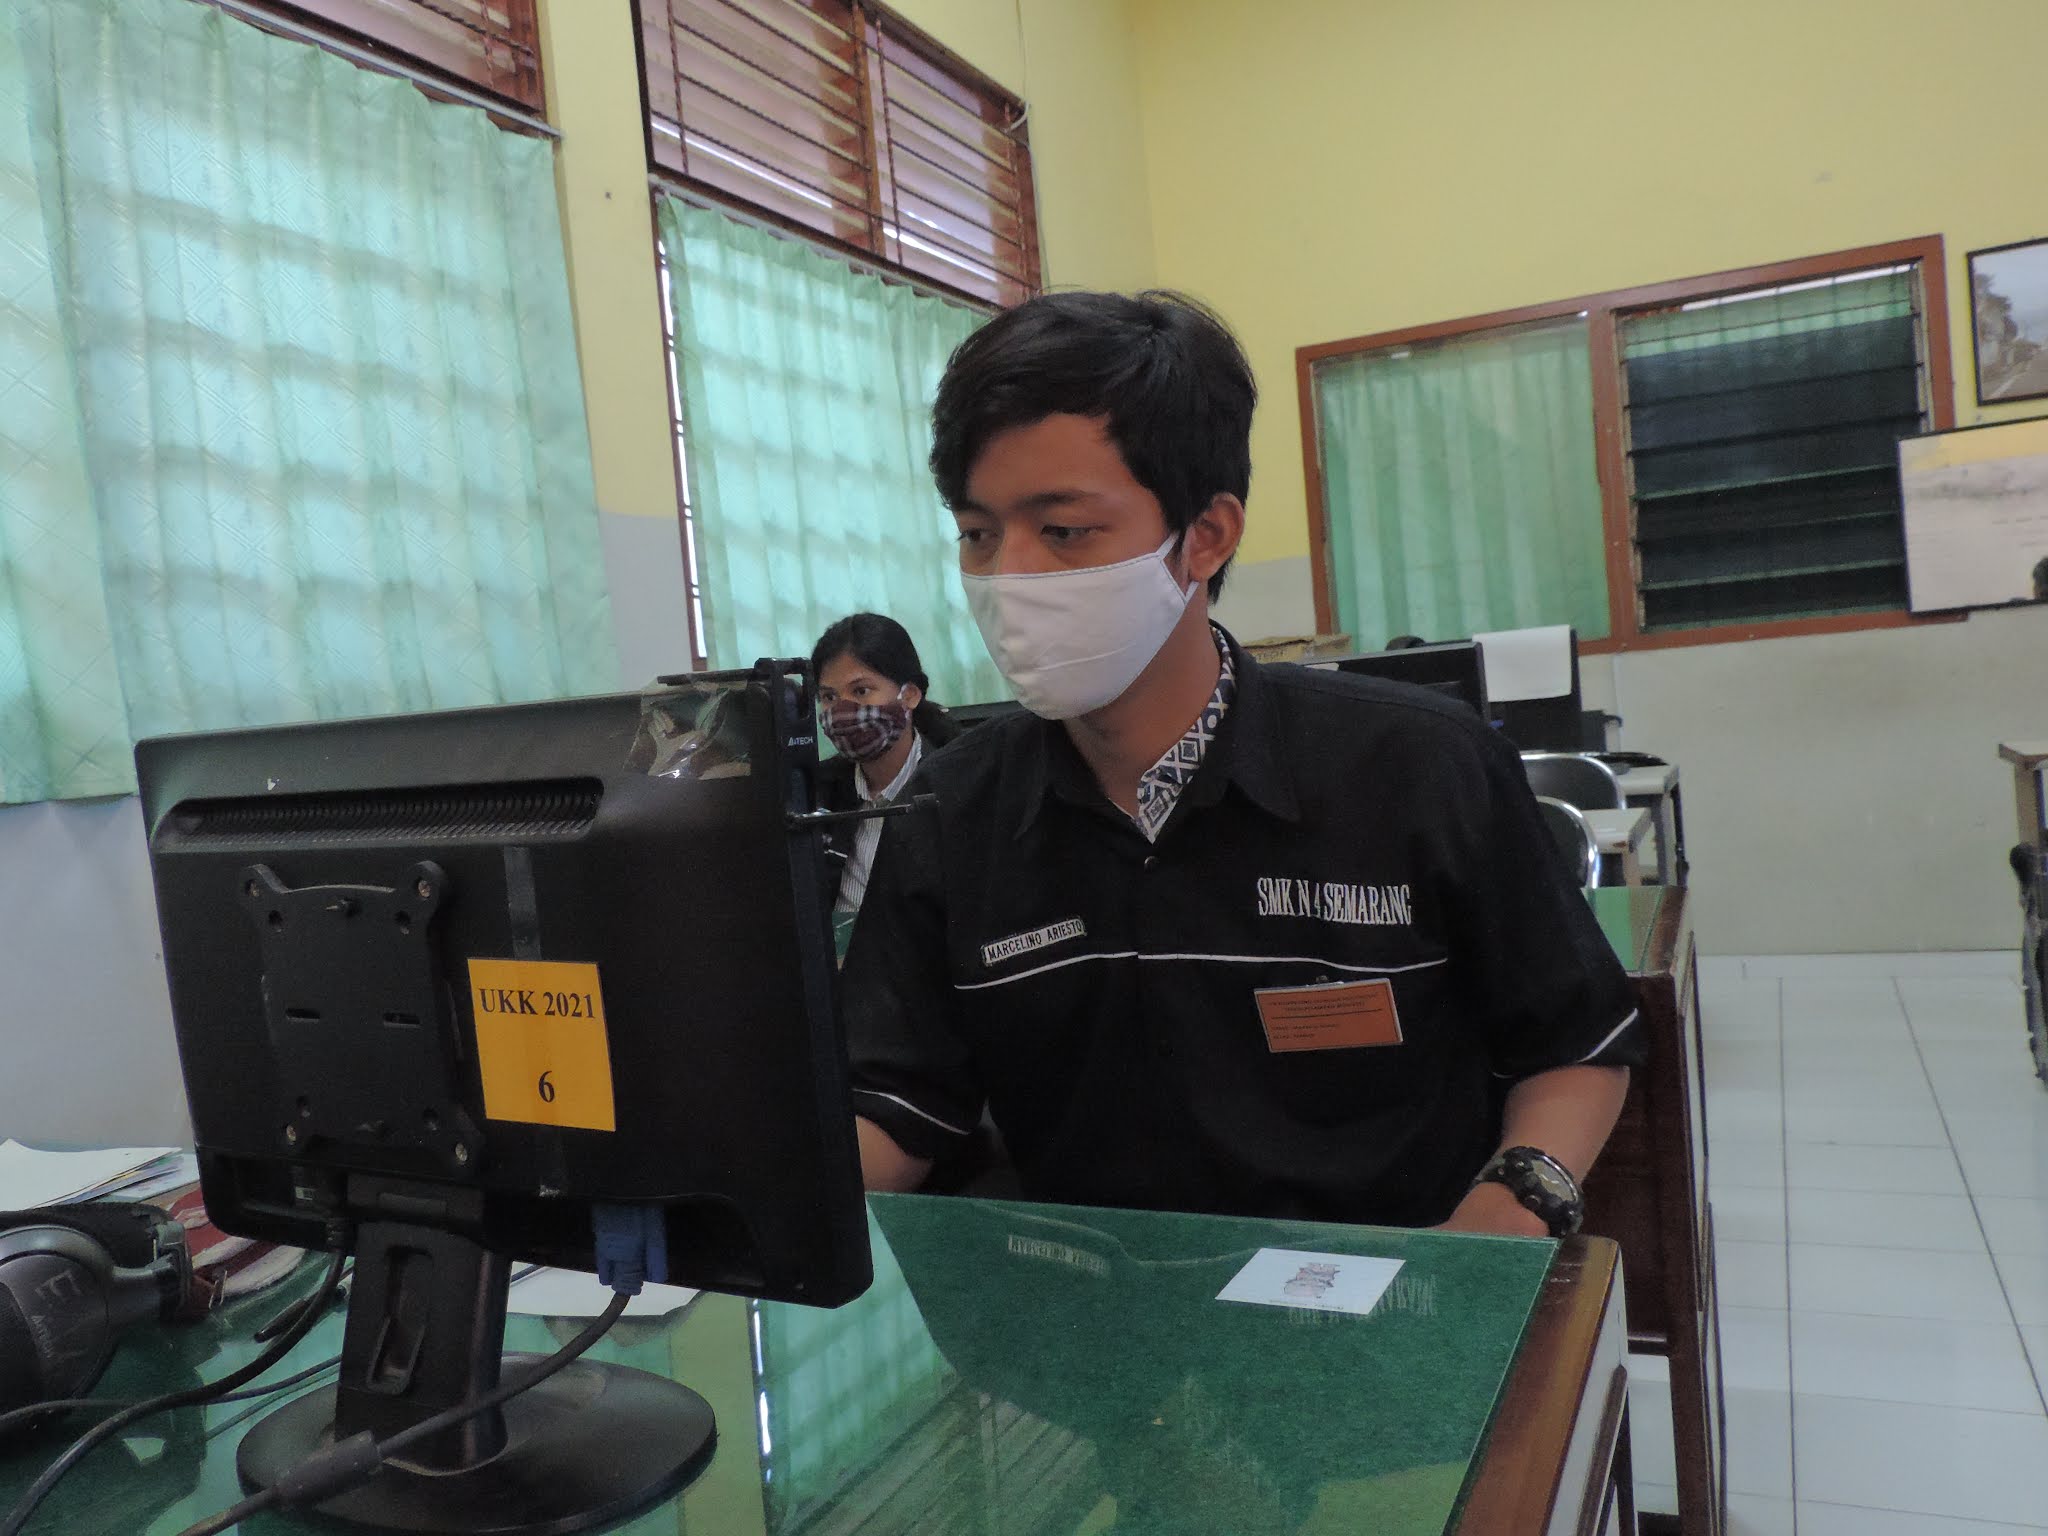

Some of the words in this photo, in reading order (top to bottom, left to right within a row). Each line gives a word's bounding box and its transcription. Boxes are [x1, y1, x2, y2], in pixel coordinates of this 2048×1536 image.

[1256, 877, 1296, 917] SMK
[1296, 879, 1312, 918] N
[1322, 882, 1412, 926] SEMARANG
[987, 932, 1042, 961] MARCELINO
[1046, 919, 1083, 942] ARIESTO
[479, 988, 539, 1016] UKK
[542, 991, 596, 1019] 2021
[537, 1070, 556, 1104] 6
